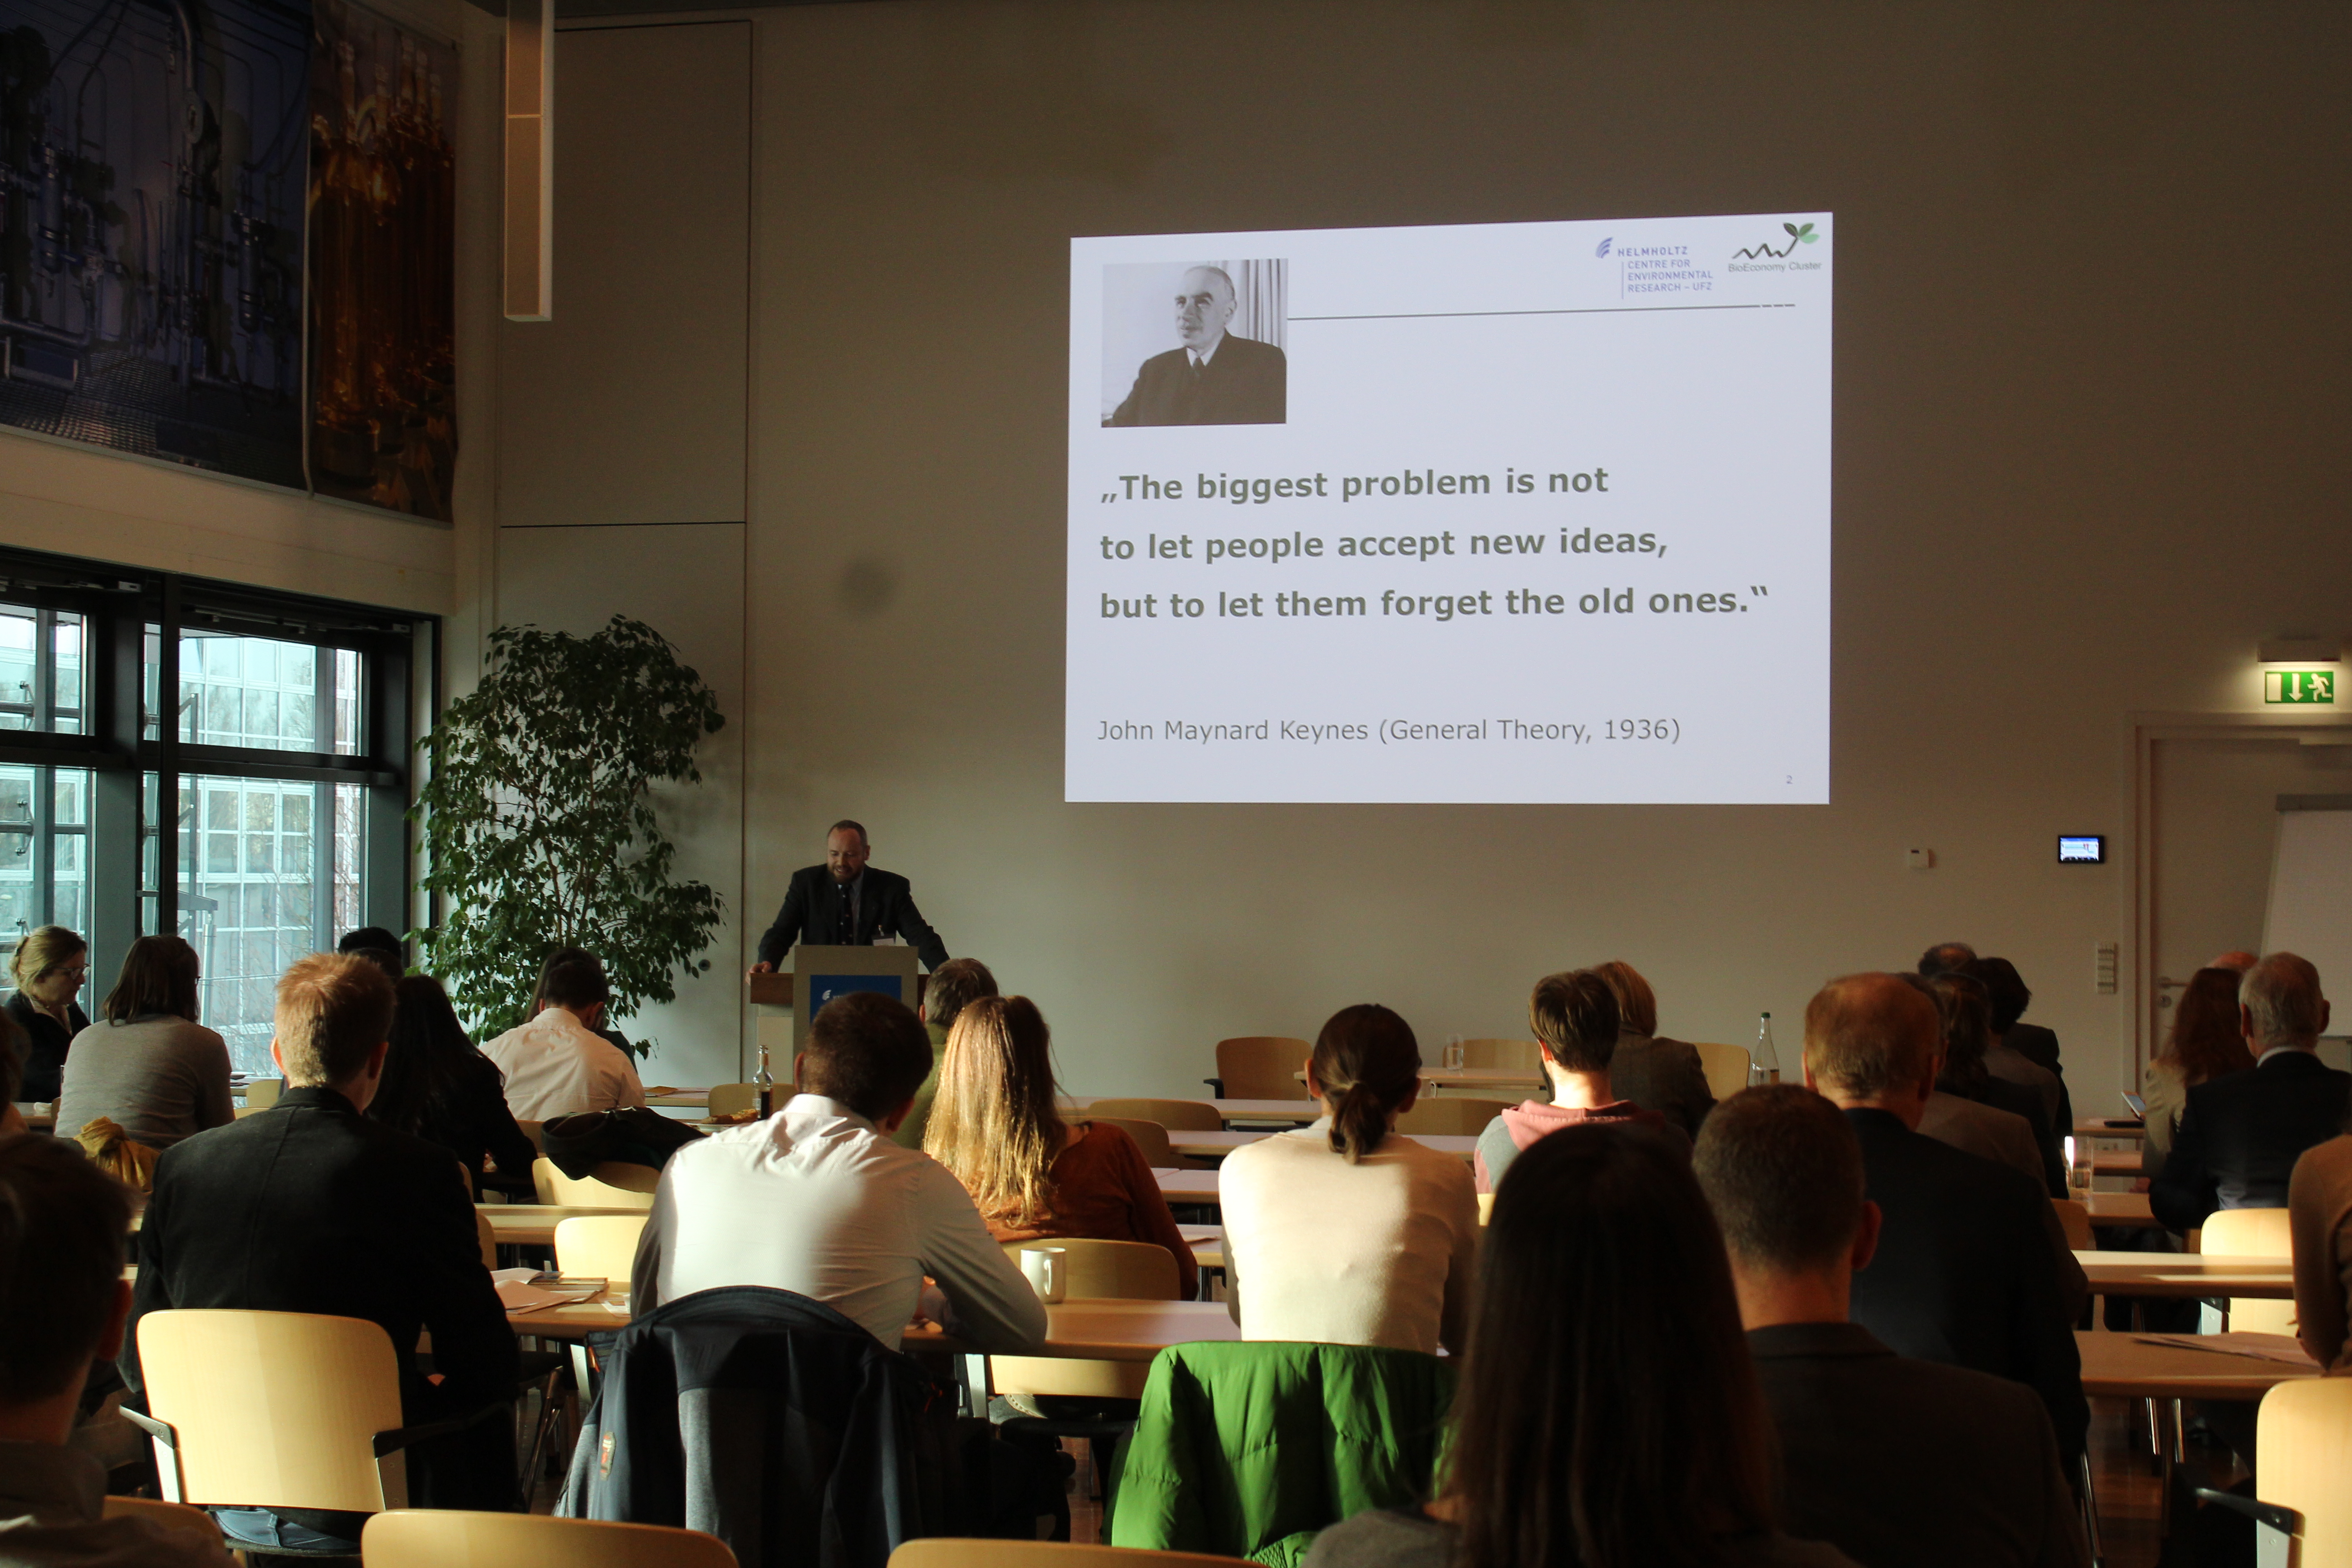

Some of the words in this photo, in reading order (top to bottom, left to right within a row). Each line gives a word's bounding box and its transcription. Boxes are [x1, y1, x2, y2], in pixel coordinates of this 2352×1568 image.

[1618, 246, 1688, 257] HELMHOLTZ
[1628, 260, 1668, 269] CENTRE
[1671, 259, 1691, 269] FOR
[1728, 262, 1786, 273] BioEconomy
[1788, 261, 1822, 271] Cluster
[1628, 270, 1714, 280] ENVIRONMENTAL
[1628, 282, 1681, 293] RESEARCH
[1692, 281, 1712, 291] UFZ
[1101, 474, 1182, 503] „The
[1198, 473, 1328, 505] biggest
[1343, 469, 1490, 503] problem
[1507, 468, 1534, 495] is
[1549, 468, 1608, 494] not
[1100, 536, 1134, 560] to
[1149, 534, 1193, 559] let
[1206, 531, 1323, 564] people
[1338, 531, 1455, 562] accept
[1471, 534, 1545, 554] new
[1561, 527, 1667, 558] ideas,
[1101, 593, 1157, 618] but
[1170, 594, 1204, 617] to
[1219, 592, 1263, 617] let
[1275, 591, 1366, 617] them
[1381, 589, 1492, 622] forget
[1505, 588, 1564, 614] the
[1579, 587, 1633, 614] old
[1098, 720, 1152, 740] John
[1165, 720, 1268, 745] Maynard
[1281, 720, 1368, 745] Keynes
[1380, 719, 1486, 745] (General
[1497, 719, 1591, 745] Theory,
[1605, 718, 1680, 745] 1936)
[1786, 774, 1793, 784] 2
